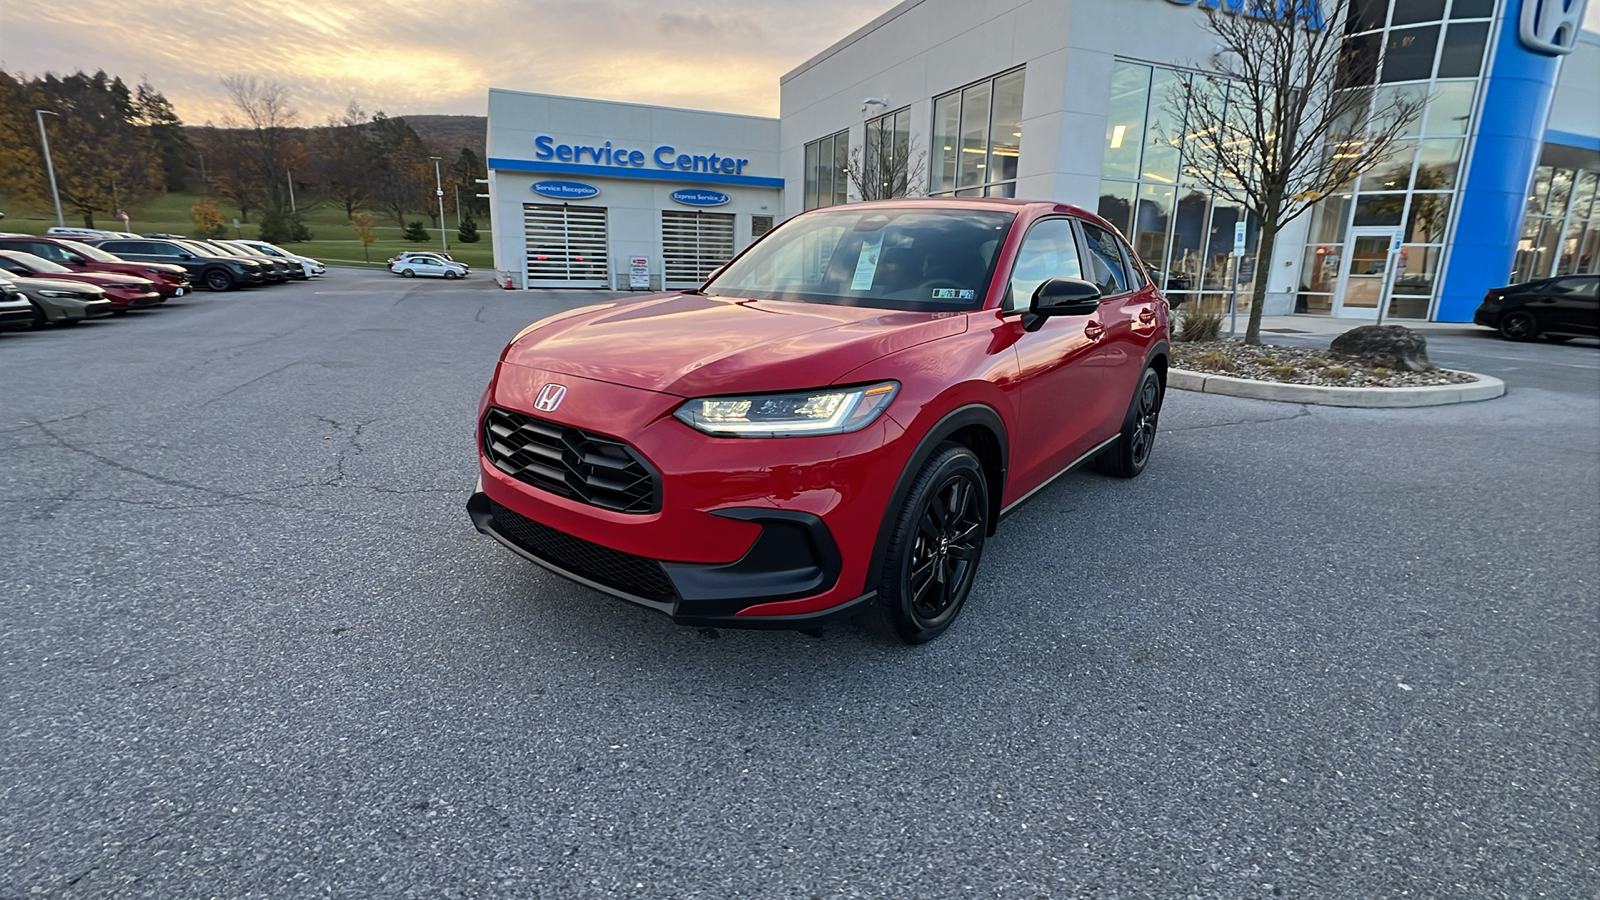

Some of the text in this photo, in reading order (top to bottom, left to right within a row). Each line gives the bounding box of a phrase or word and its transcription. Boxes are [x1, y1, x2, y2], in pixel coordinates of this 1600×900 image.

[534, 135, 749, 175] Service Center
[535, 184, 596, 194] Service Reception
[673, 192, 697, 201] Express
